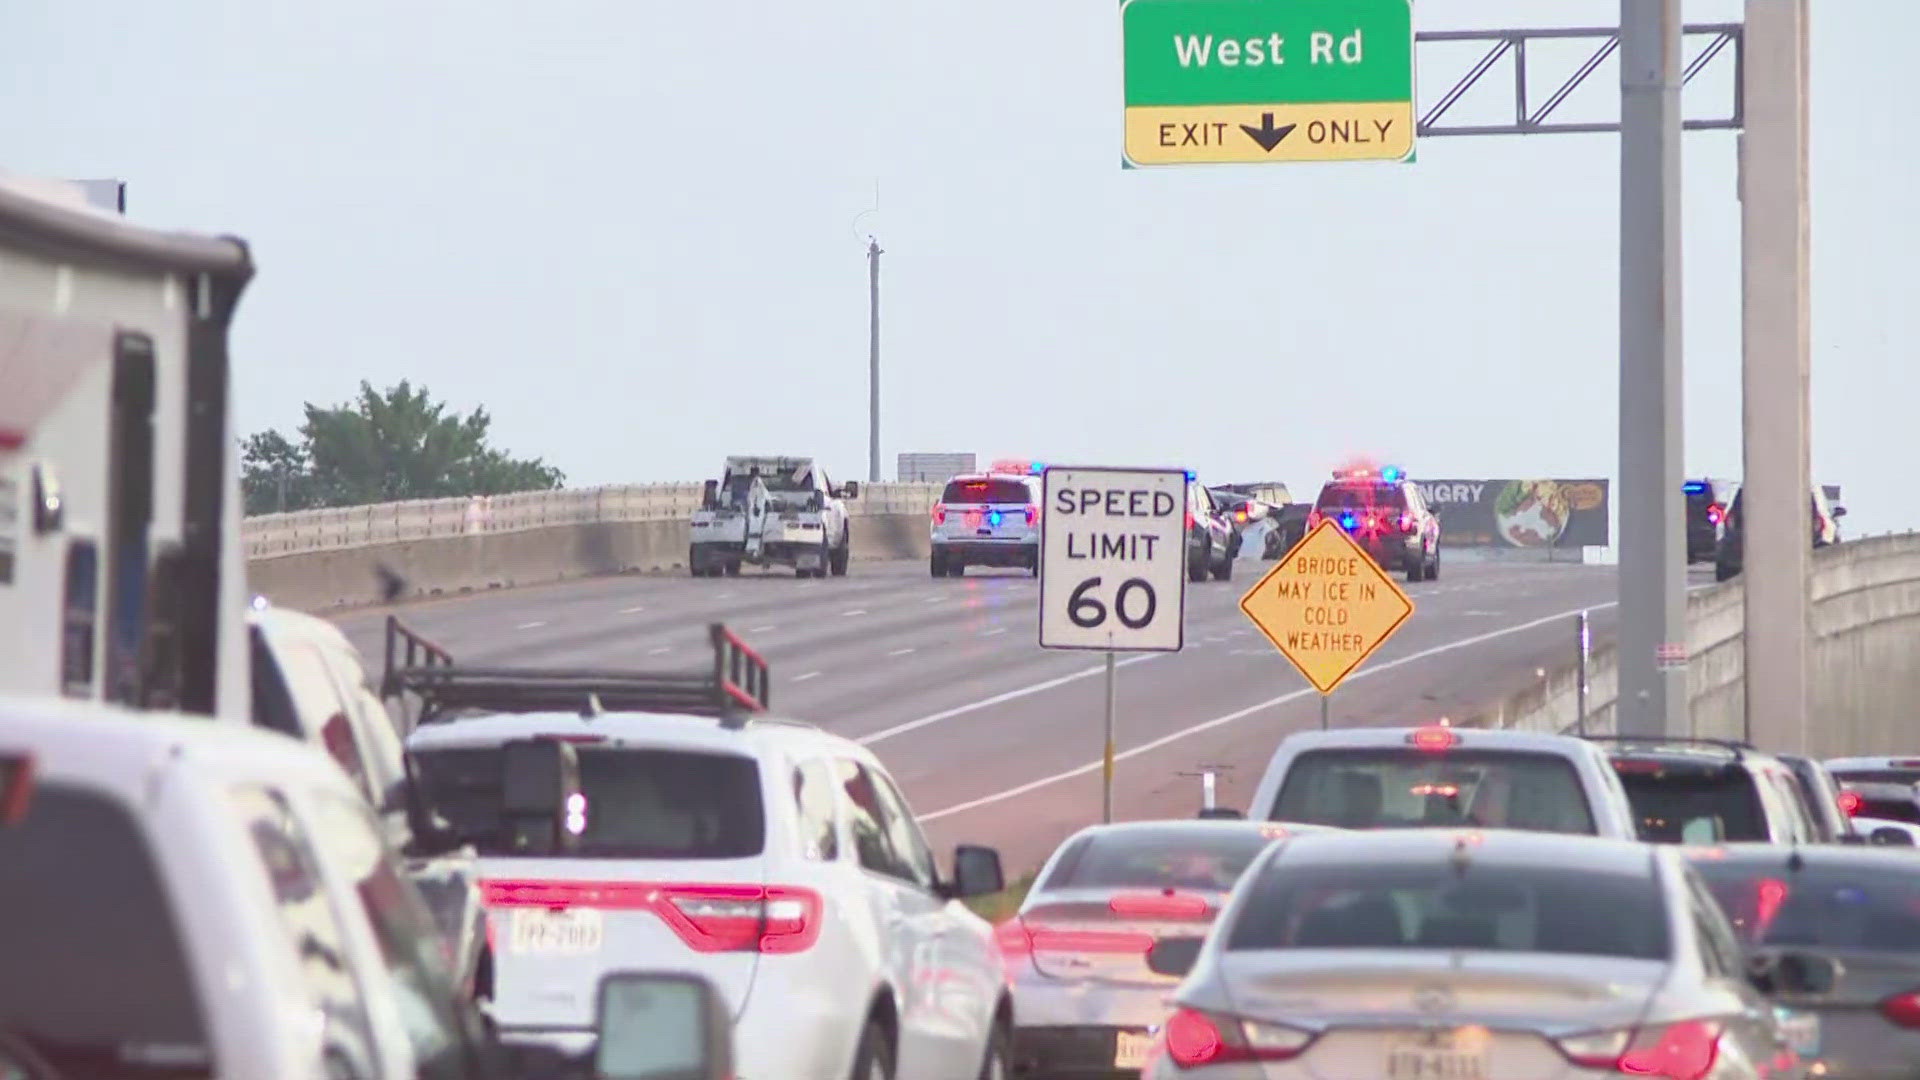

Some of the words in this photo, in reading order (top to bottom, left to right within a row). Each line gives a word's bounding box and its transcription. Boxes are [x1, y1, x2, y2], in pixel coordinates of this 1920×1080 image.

[1174, 33, 1285, 67] West
[1310, 28, 1363, 64] Rd
[1159, 122, 1228, 147] EXIT
[1307, 119, 1393, 144] ONLY
[1056, 489, 1174, 517] SPEED
[1067, 533, 1160, 561] LIMIT
[1297, 557, 1358, 577] BRIDGE
[1067, 576, 1157, 630] 60
[1277, 582, 1312, 600] MAY
[1322, 582, 1347, 600] ICE
[1359, 582, 1376, 600] IN
[1304, 606, 1348, 626] COLD
[1286, 633, 1363, 652] WEATHER
